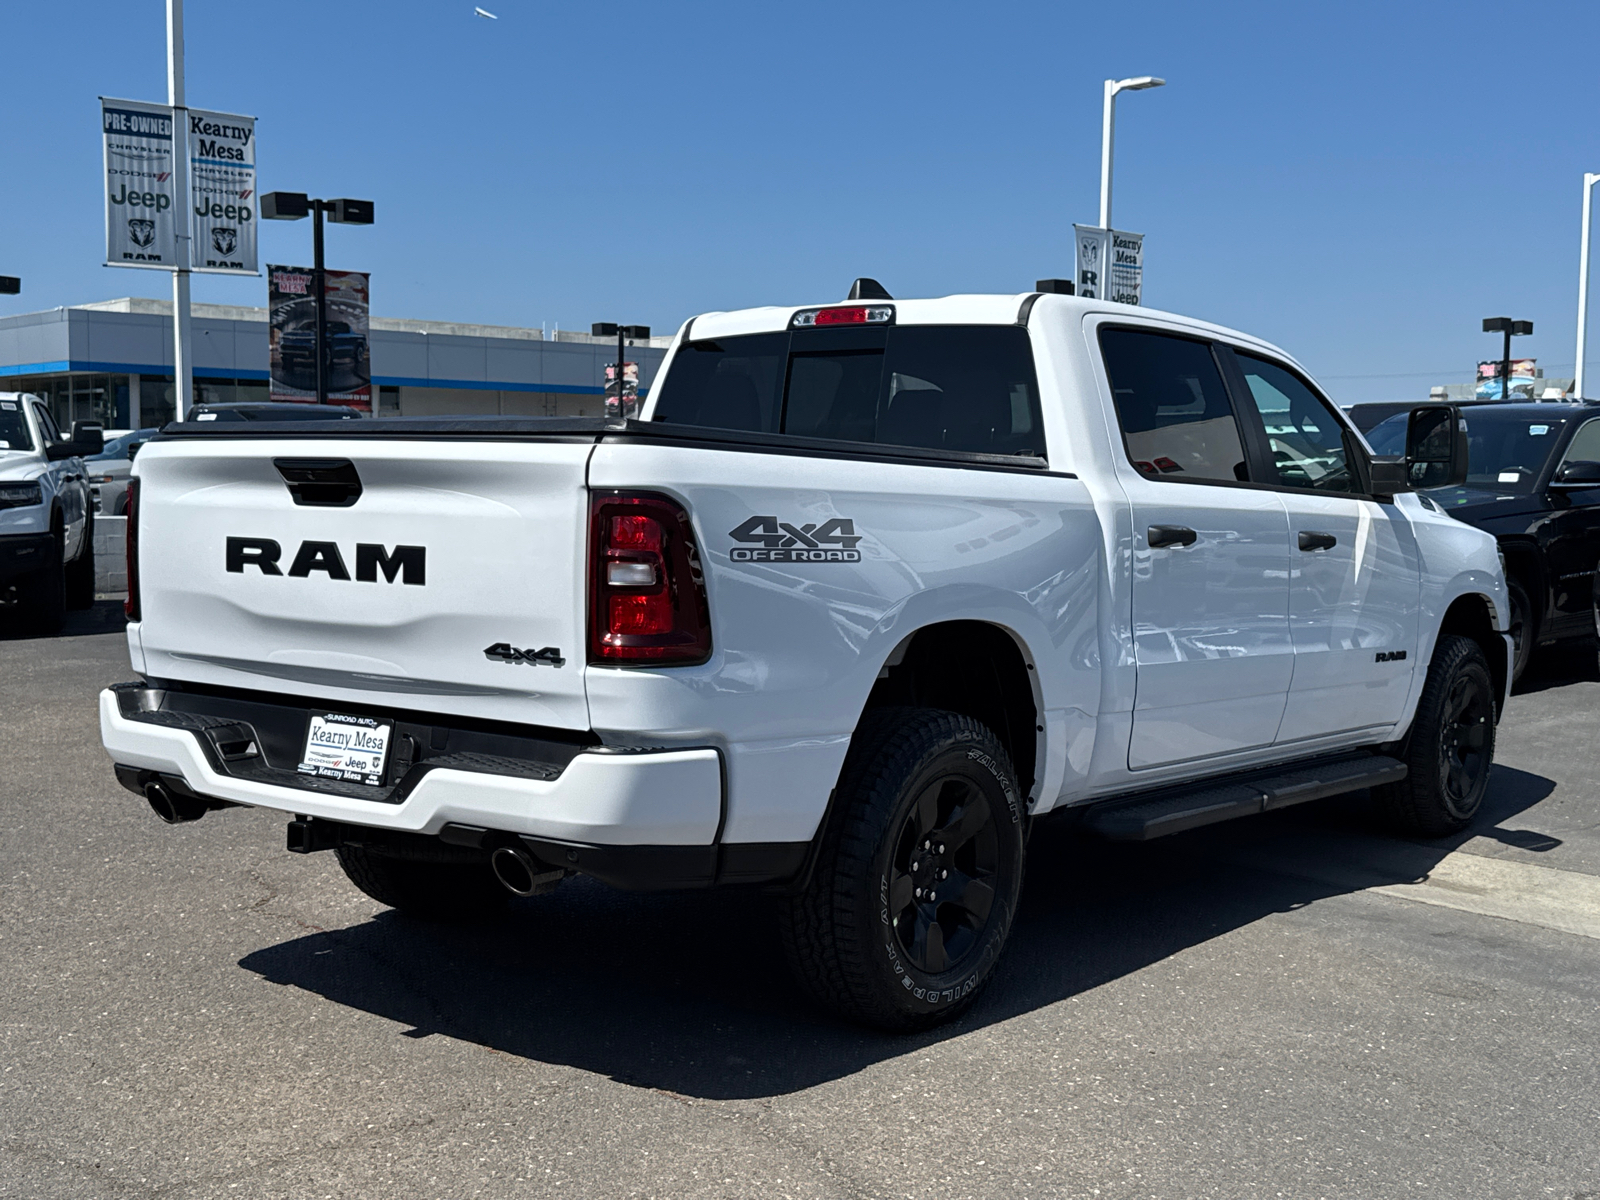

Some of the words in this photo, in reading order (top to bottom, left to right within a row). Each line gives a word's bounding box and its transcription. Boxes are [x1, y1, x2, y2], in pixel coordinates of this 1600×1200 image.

[105, 113, 171, 135] PRE-OWNED
[190, 117, 252, 146] Kearny
[108, 143, 170, 154] CHRYSLER
[200, 140, 245, 161] Mesa
[193, 166, 252, 177] CHRYSLER
[111, 184, 170, 213] Jeep
[195, 197, 252, 225] Jeep
[1113, 235, 1142, 254] Kearny
[123, 252, 161, 261] RAM
[207, 260, 243, 268] RAM
[1116, 251, 1137, 265] Mesa
[273, 273, 312, 285] KEARNY
[279, 283, 307, 294] MESA
[1112, 289, 1138, 305] Jeep
[728, 516, 863, 548] 4x4
[226, 536, 426, 586] RAM
[732, 550, 785, 561] OFF
[791, 551, 859, 561] ROAD
[483, 642, 566, 668] 4x4
[1375, 651, 1407, 662] RAM
[326, 713, 356, 723] SUNROAD
[357, 717, 374, 726] AUTO
[311, 726, 352, 751] Kearny
[354, 731, 384, 750] Mesa
[345, 756, 367, 771] Jeep
[318, 766, 343, 780] Kearny
[343, 770, 361, 781] Mesa
[885, 941, 980, 1004] WILDPEAK
